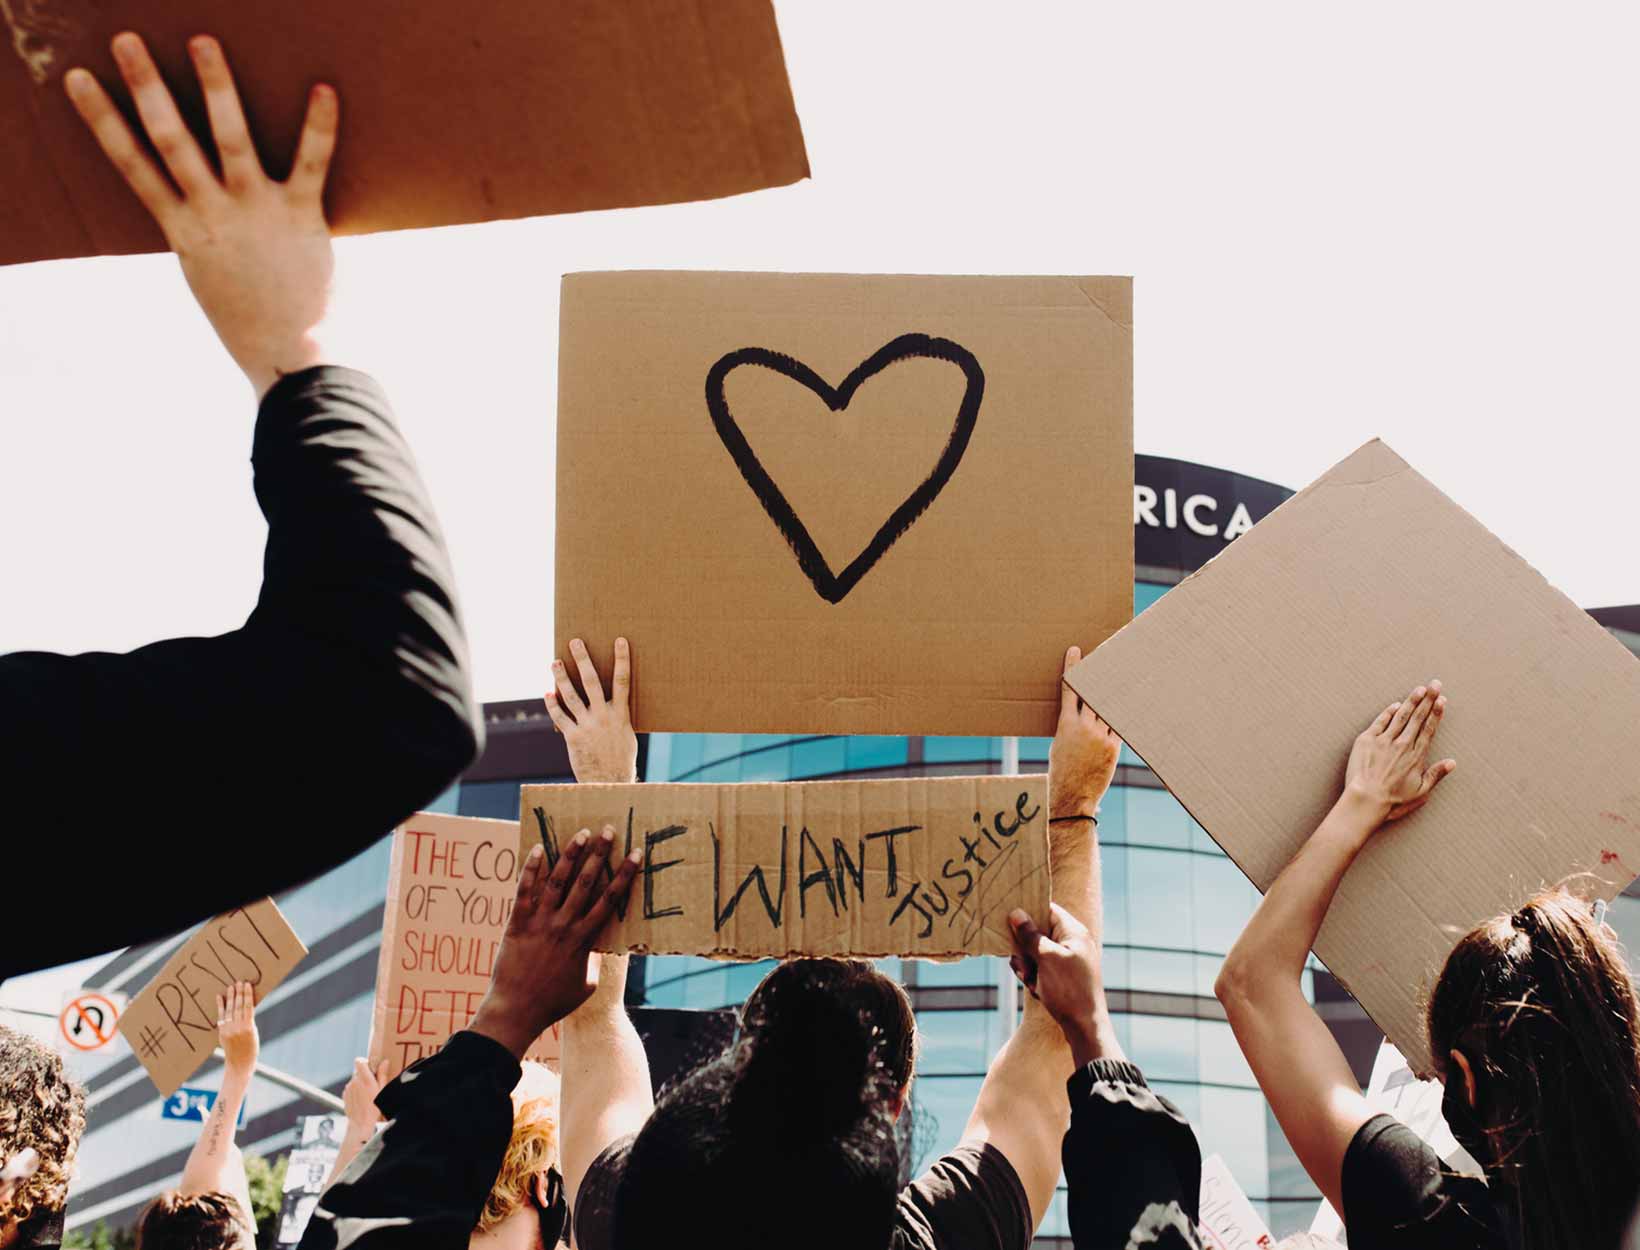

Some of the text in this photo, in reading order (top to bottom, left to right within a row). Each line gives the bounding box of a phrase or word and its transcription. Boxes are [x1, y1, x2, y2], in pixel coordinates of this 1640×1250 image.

[1134, 484, 1253, 541] RICA
[406, 831, 519, 883] THE CO
[708, 821, 924, 934] WANT
[405, 884, 447, 922] OF
[140, 906, 280, 1059] #RESIST
[396, 984, 486, 1035] DETE
